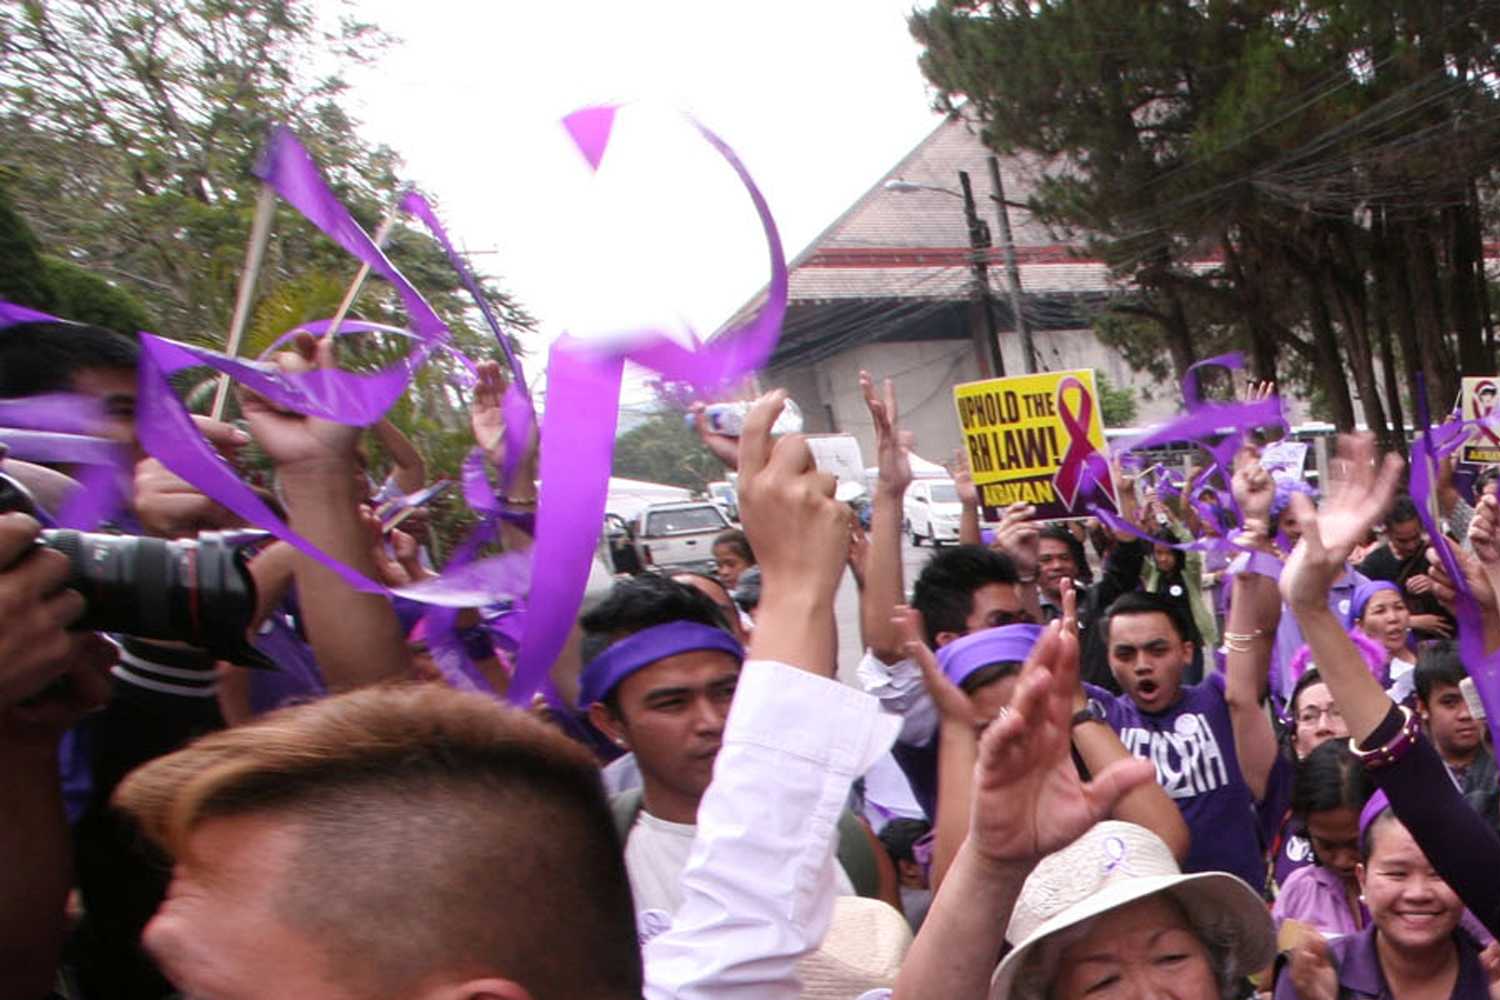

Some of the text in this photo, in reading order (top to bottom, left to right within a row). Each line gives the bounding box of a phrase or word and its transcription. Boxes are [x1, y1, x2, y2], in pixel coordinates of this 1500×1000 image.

[957, 391, 1057, 431] UPHOLD THE
[967, 425, 1063, 473] RH LAW!
